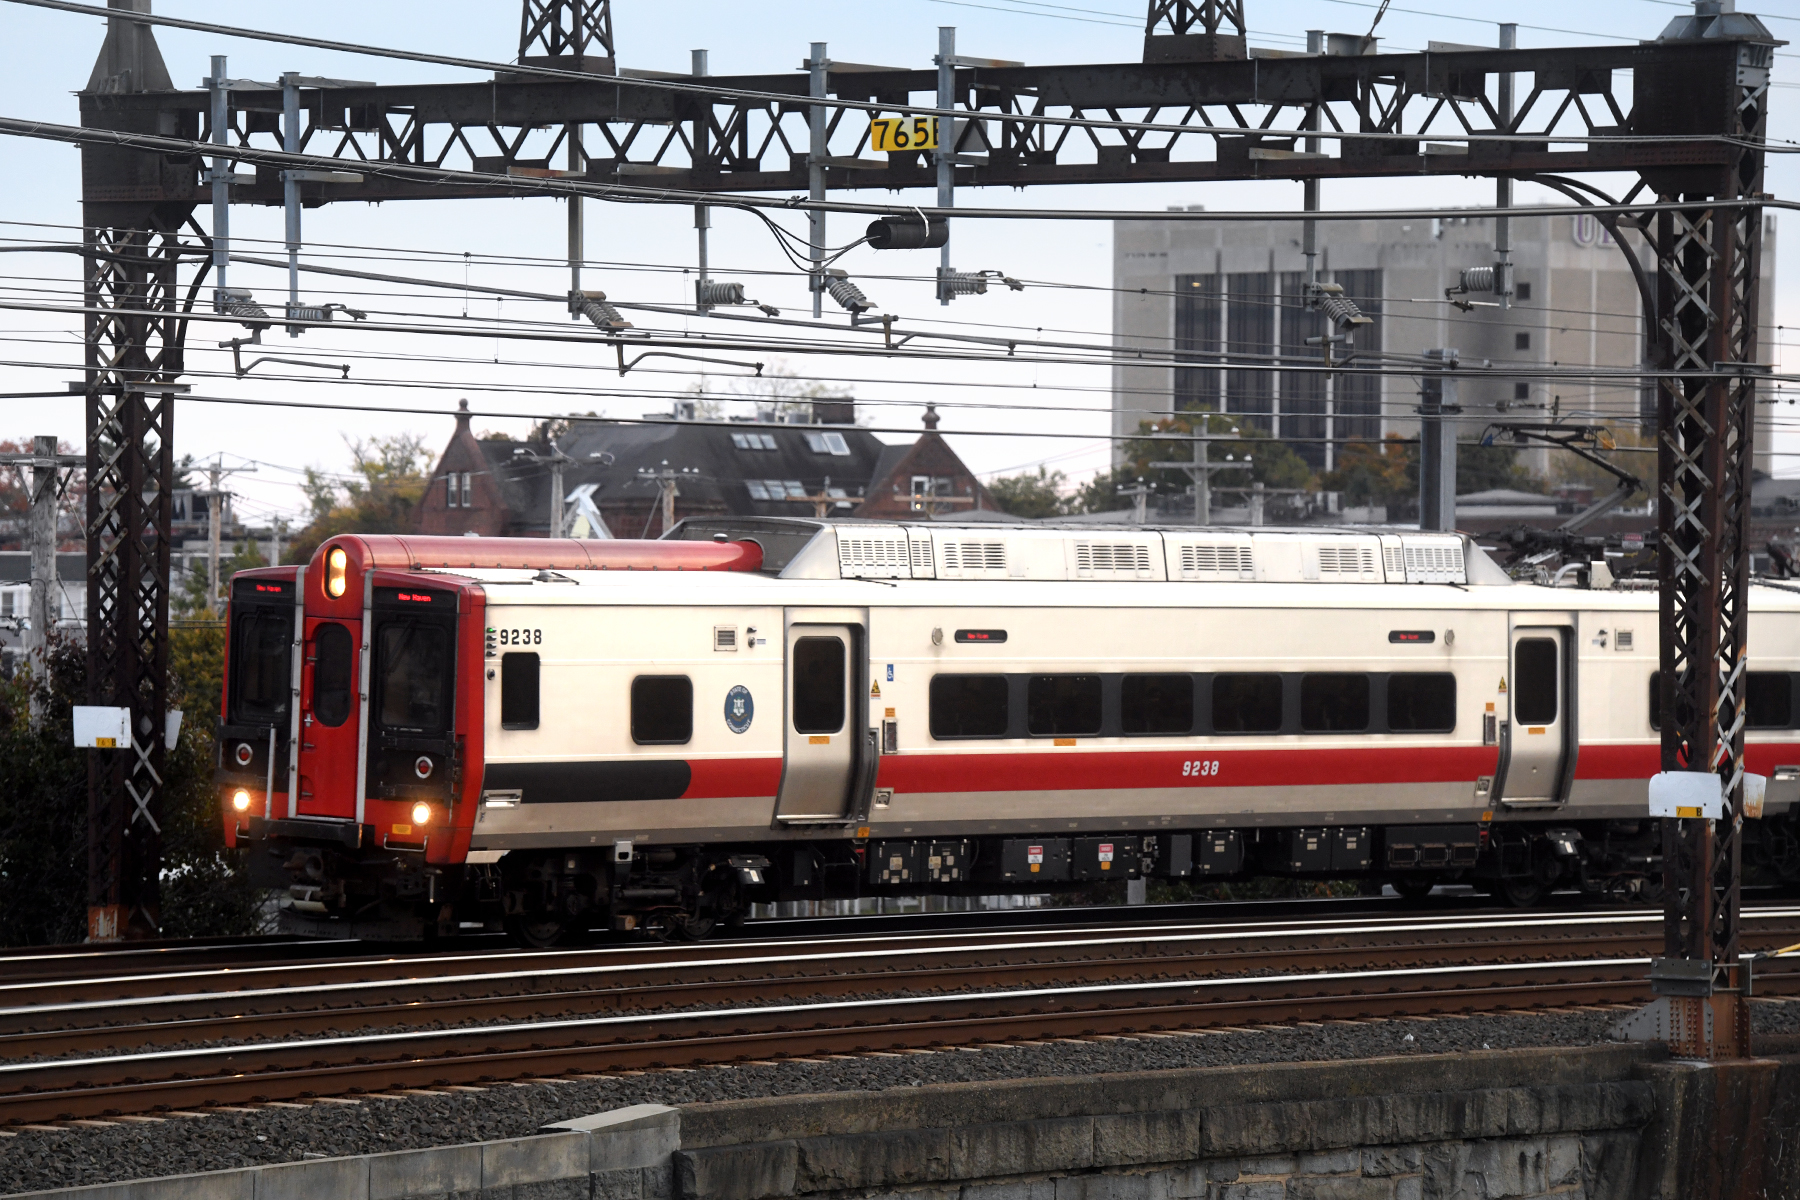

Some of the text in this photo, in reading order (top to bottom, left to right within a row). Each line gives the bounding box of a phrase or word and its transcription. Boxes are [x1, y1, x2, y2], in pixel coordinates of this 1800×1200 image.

[398, 593, 431, 602] New Haven
[500, 629, 542, 645] 9238
[1182, 760, 1220, 776] 9238
